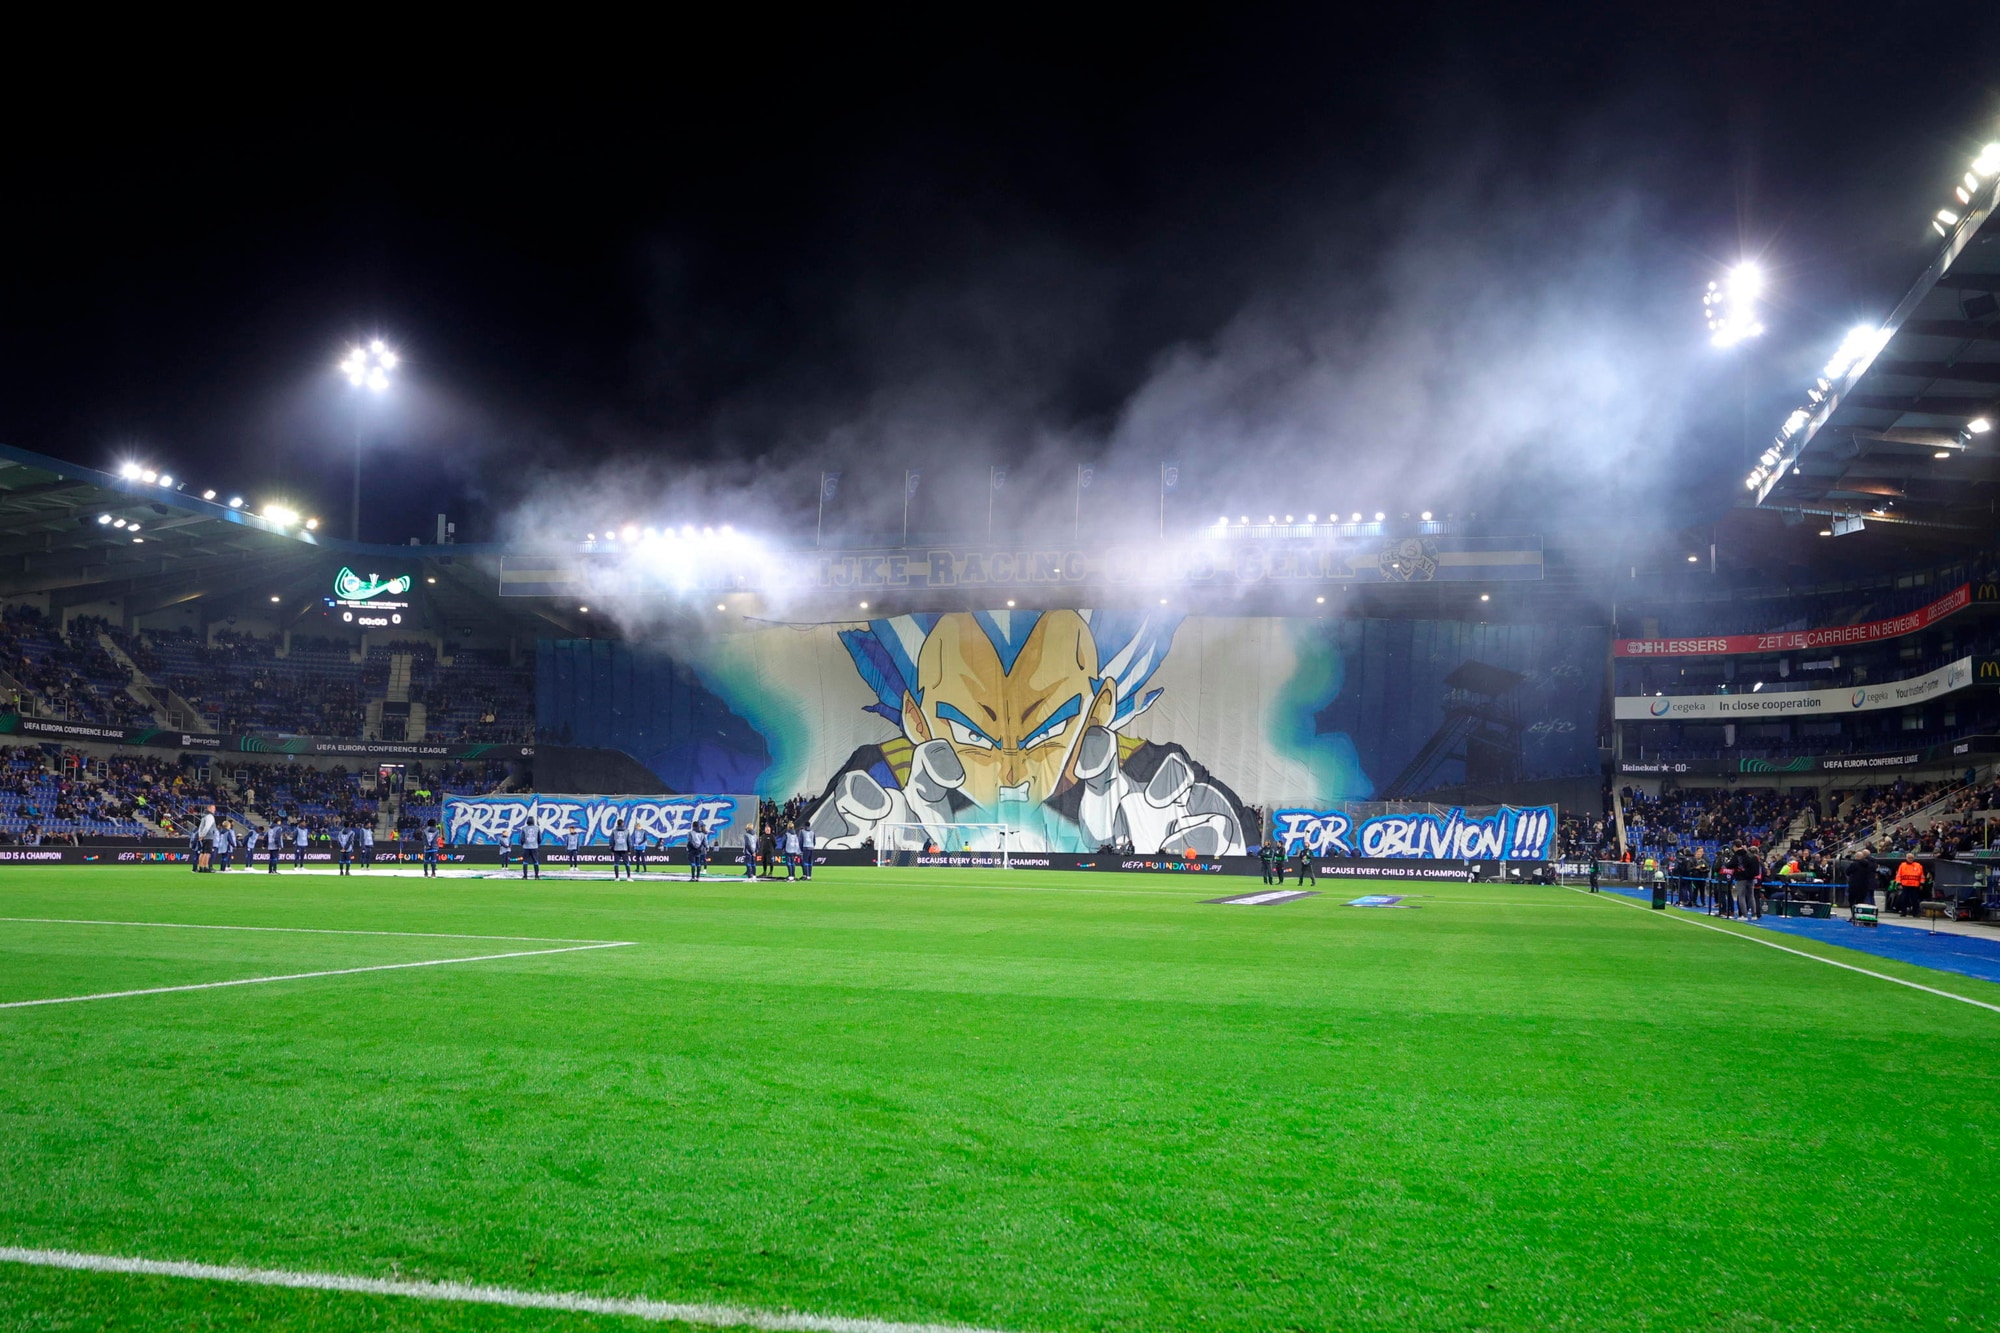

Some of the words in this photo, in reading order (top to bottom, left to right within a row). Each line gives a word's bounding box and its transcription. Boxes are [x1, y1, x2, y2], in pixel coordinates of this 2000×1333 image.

[927, 550, 1088, 588] RACING
[1234, 544, 1357, 583] GENK
[342, 611, 353, 623] 0
[358, 617, 388, 626] 00:00
[391, 613, 402, 625] 0
[1757, 635, 1784, 649] ZET
[1787, 633, 1803, 647] JE
[1807, 625, 1867, 646] CARRIÈRE
[1869, 623, 1881, 637] IN
[1882, 613, 1920, 634] BEWEGING
[1653, 639, 1728, 653] H.ESSERS
[1895, 687, 1909, 699] Your
[1672, 700, 1706, 713] cegeka
[1719, 701, 1730, 711] In
[1731, 700, 1760, 711] close
[1761, 698, 1822, 711] cooperation
[23, 721, 40, 731] UEFA
[40, 723, 64, 733] EUROPA
[64, 726, 102, 736] CONFERENCE
[102, 729, 124, 738] LEAGUE
[337, 744, 367, 752] EUROPA
[367, 745, 418, 753] CONFERENCE
[419, 746, 448, 754] LEAGUE
[1622, 763, 1660, 772] Heineken
[1823, 760, 1843, 769] UEFA
[1843, 759, 1868, 768] EUROPA
[1868, 756, 1904, 767] CONFERENCE
[1904, 754, 1919, 763] LEAGUE
[447, 799, 587, 845] PREPARE
[1279, 812, 1349, 857] FOR
[1362, 808, 1508, 860] OBLIVION
[13, 852, 19, 860] IS
[20, 852, 26, 860] A
[26, 852, 62, 860] CHAMPION
[117, 853, 135, 861] UEFA
[375, 853, 397, 861] UEFA
[576, 854, 597, 862] EVERY
[1121, 860, 1144, 869] UEFA
[1321, 866, 1355, 874] BECAUSE
[1356, 867, 1380, 875] EVERY
[1381, 868, 1405, 876] CHILD
[1406, 868, 1415, 876] IS
[1415, 869, 1422, 877] A
[1423, 869, 1468, 878] CHAMPION
